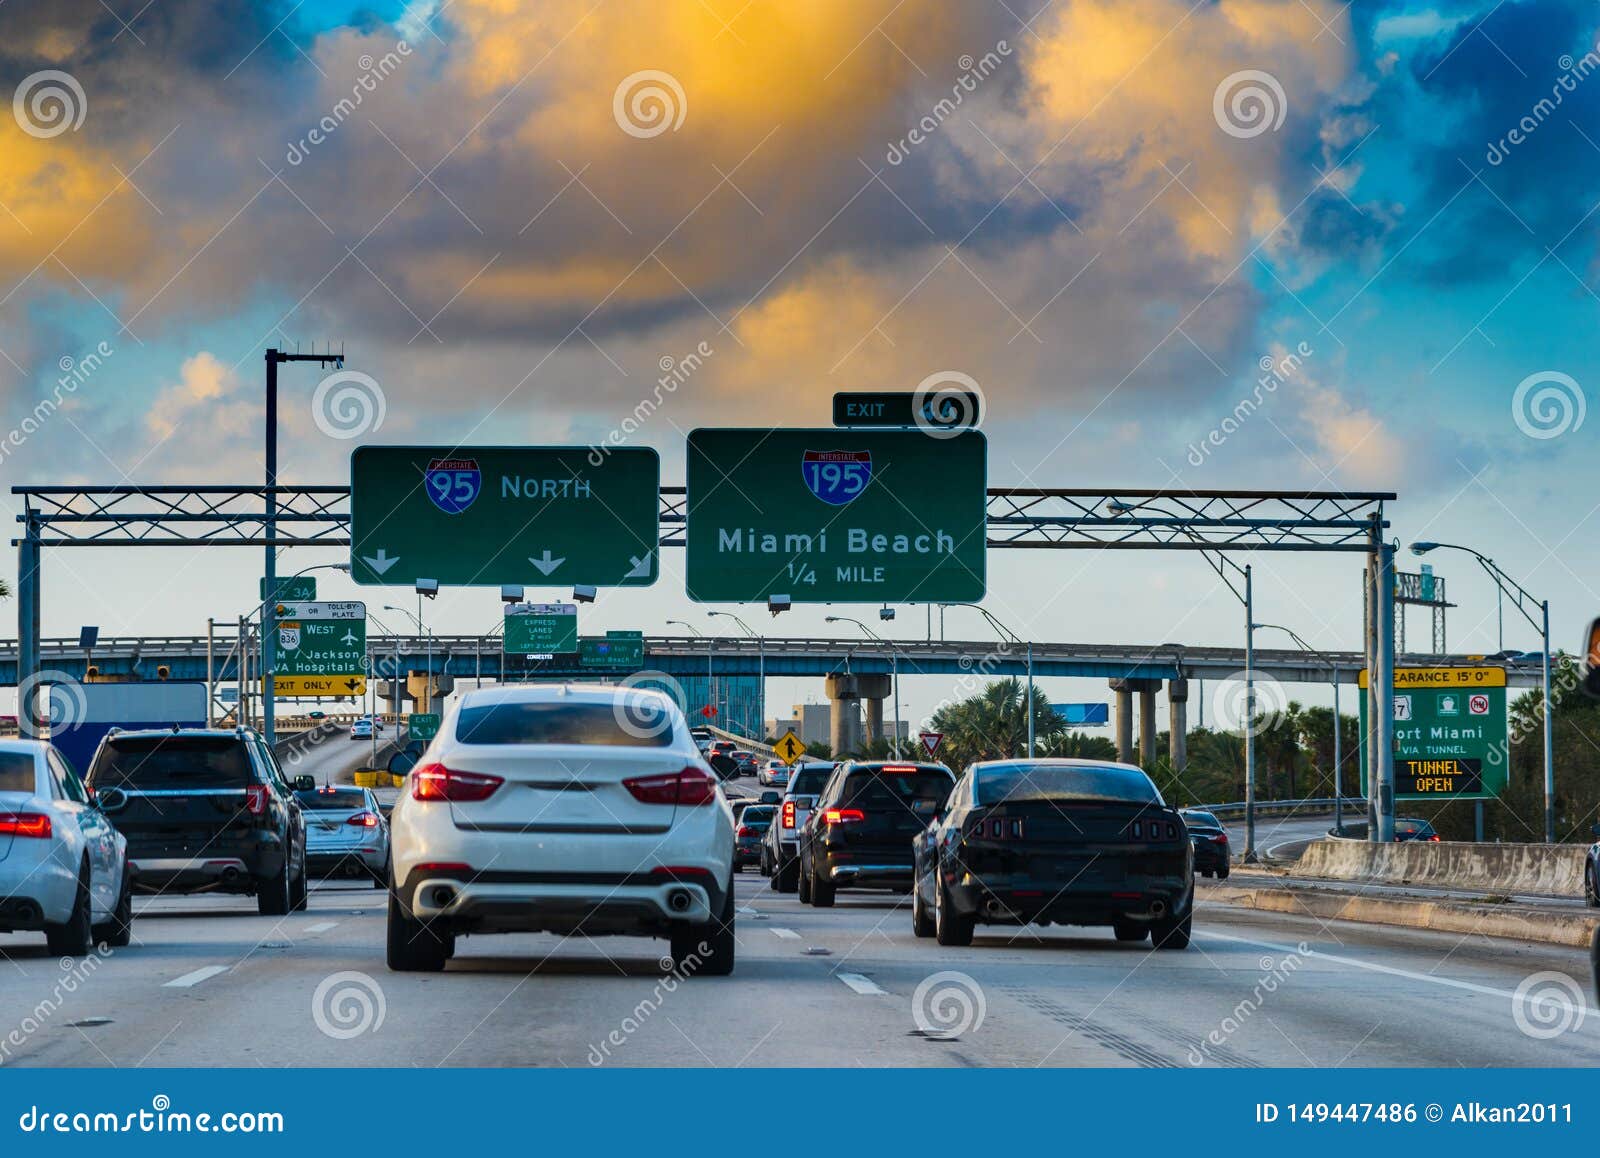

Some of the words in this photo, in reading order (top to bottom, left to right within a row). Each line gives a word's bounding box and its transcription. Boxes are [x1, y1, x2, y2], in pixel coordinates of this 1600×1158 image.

[847, 403, 885, 417] EXIT
[818, 453, 856, 461] INTERSTATE
[434, 461, 472, 469] INTERSTATE
[811, 463, 863, 494] 195
[432, 472, 474, 502] 95
[501, 475, 590, 498] NORTH
[718, 528, 827, 553] Miami
[847, 528, 954, 553] Beach
[836, 567, 885, 582] MILE
[293, 587, 310, 598] 3A
[281, 635, 296, 643] 836
[306, 624, 336, 635] WEST
[306, 650, 360, 660] Jackson
[296, 662, 355, 674] Hospitals
[1393, 672, 1450, 682] EARANCE
[303, 681, 332, 690] ONLY
[1396, 727, 1421, 739] ort
[1430, 726, 1482, 739] Miami
[1402, 746, 1419, 754] VIA
[1426, 745, 1467, 754] TUNNEL
[1408, 760, 1462, 775] TUNNEL
[1416, 778, 1453, 792] OPEN
